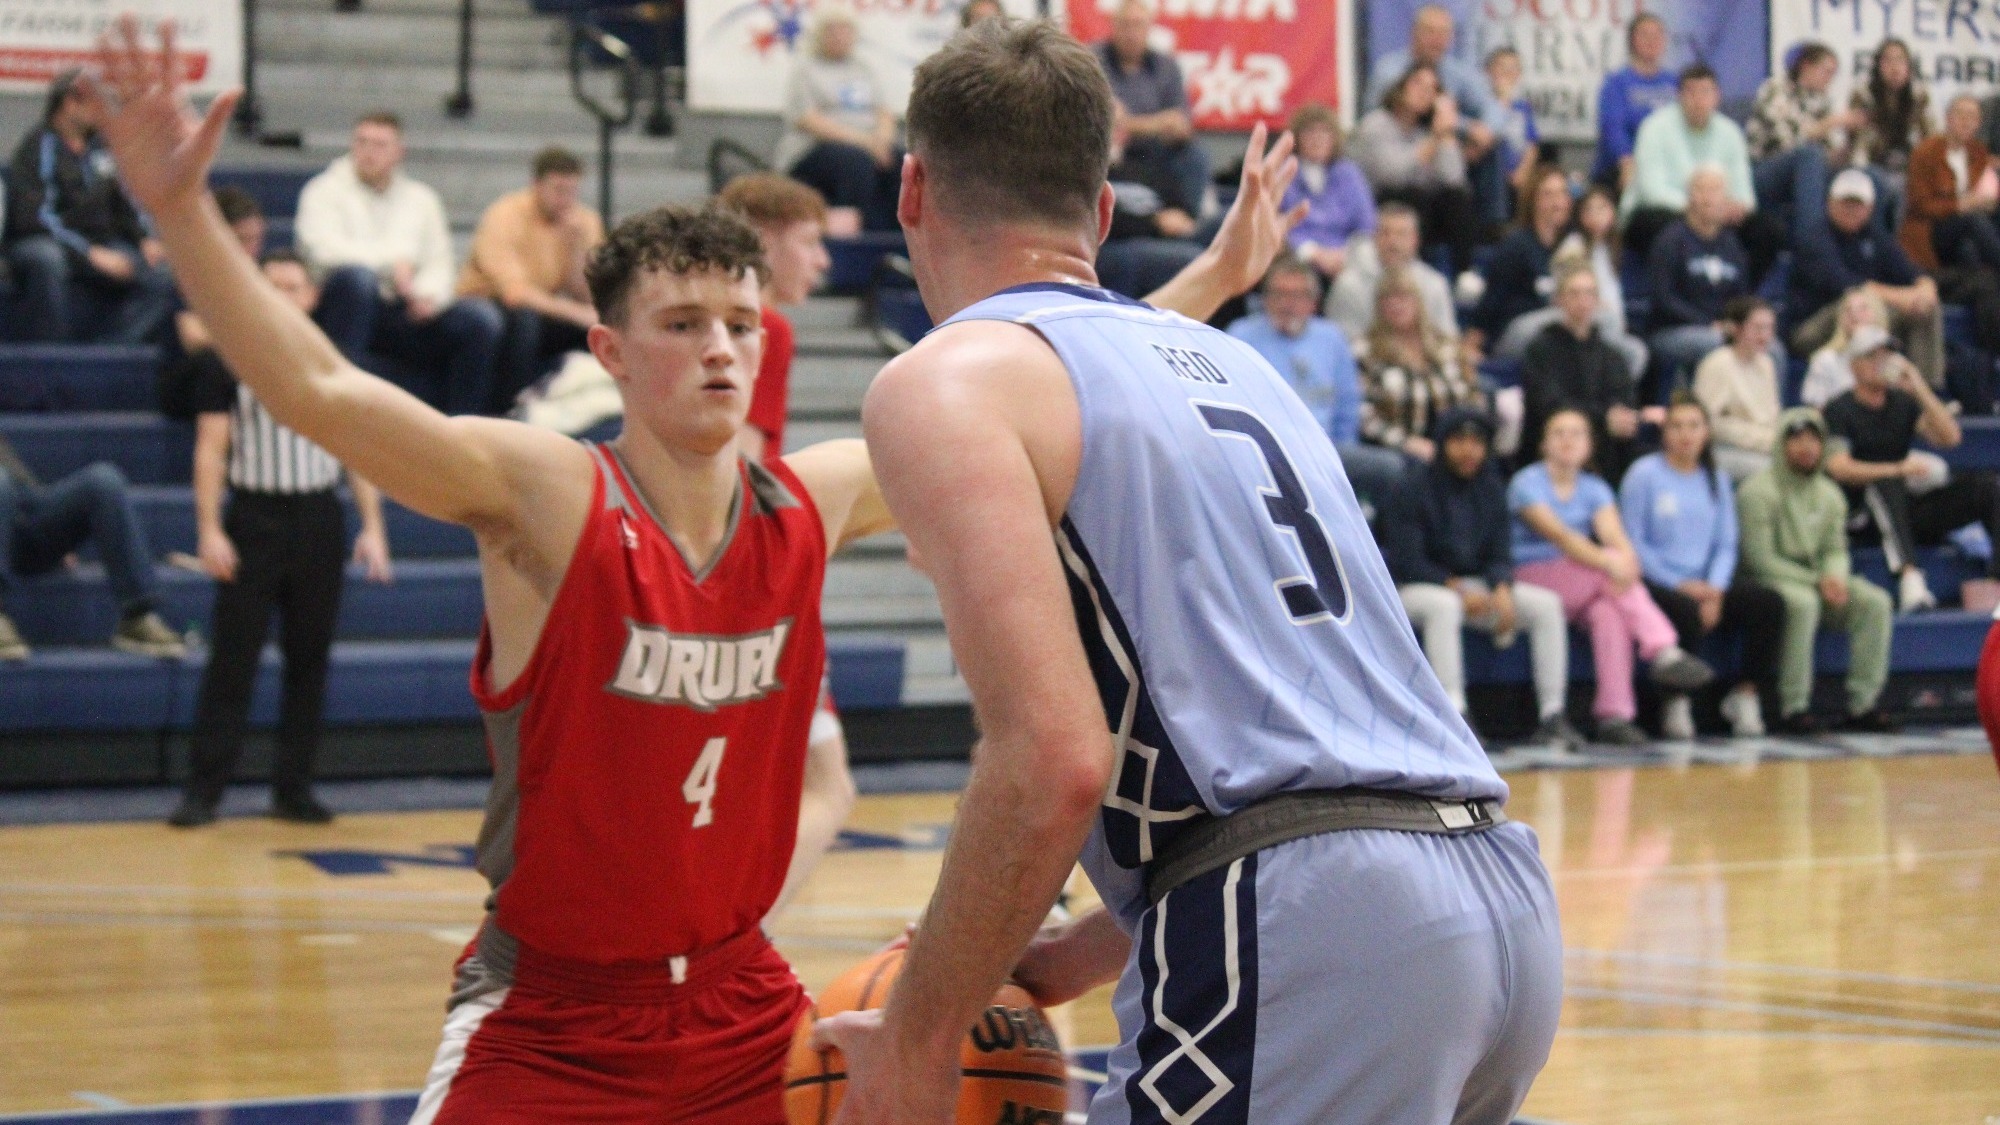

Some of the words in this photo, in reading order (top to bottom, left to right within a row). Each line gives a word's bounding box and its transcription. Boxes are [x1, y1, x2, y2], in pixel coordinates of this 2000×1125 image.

[1150, 343, 1229, 385] REID
[1189, 398, 1353, 625] 3
[682, 736, 727, 828] 4
